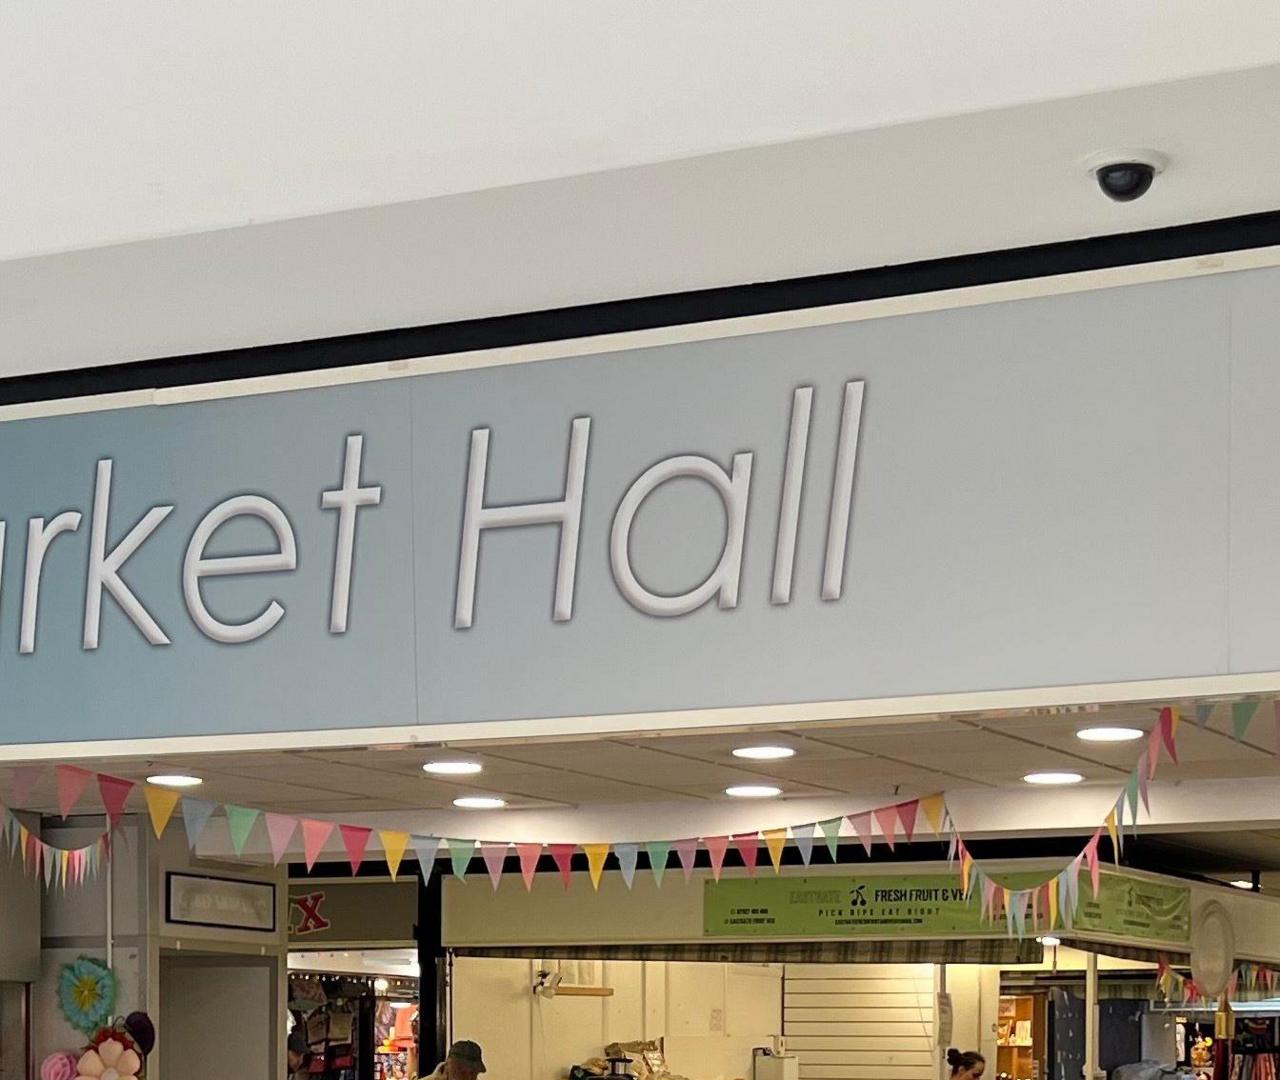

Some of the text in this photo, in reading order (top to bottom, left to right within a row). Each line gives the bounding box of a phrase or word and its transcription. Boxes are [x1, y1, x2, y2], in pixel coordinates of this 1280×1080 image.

[452, 378, 866, 632] Hall
[288, 891, 331, 935] X
[874, 889, 907, 902] FRESH
[908, 889, 939, 902] FRUIT
